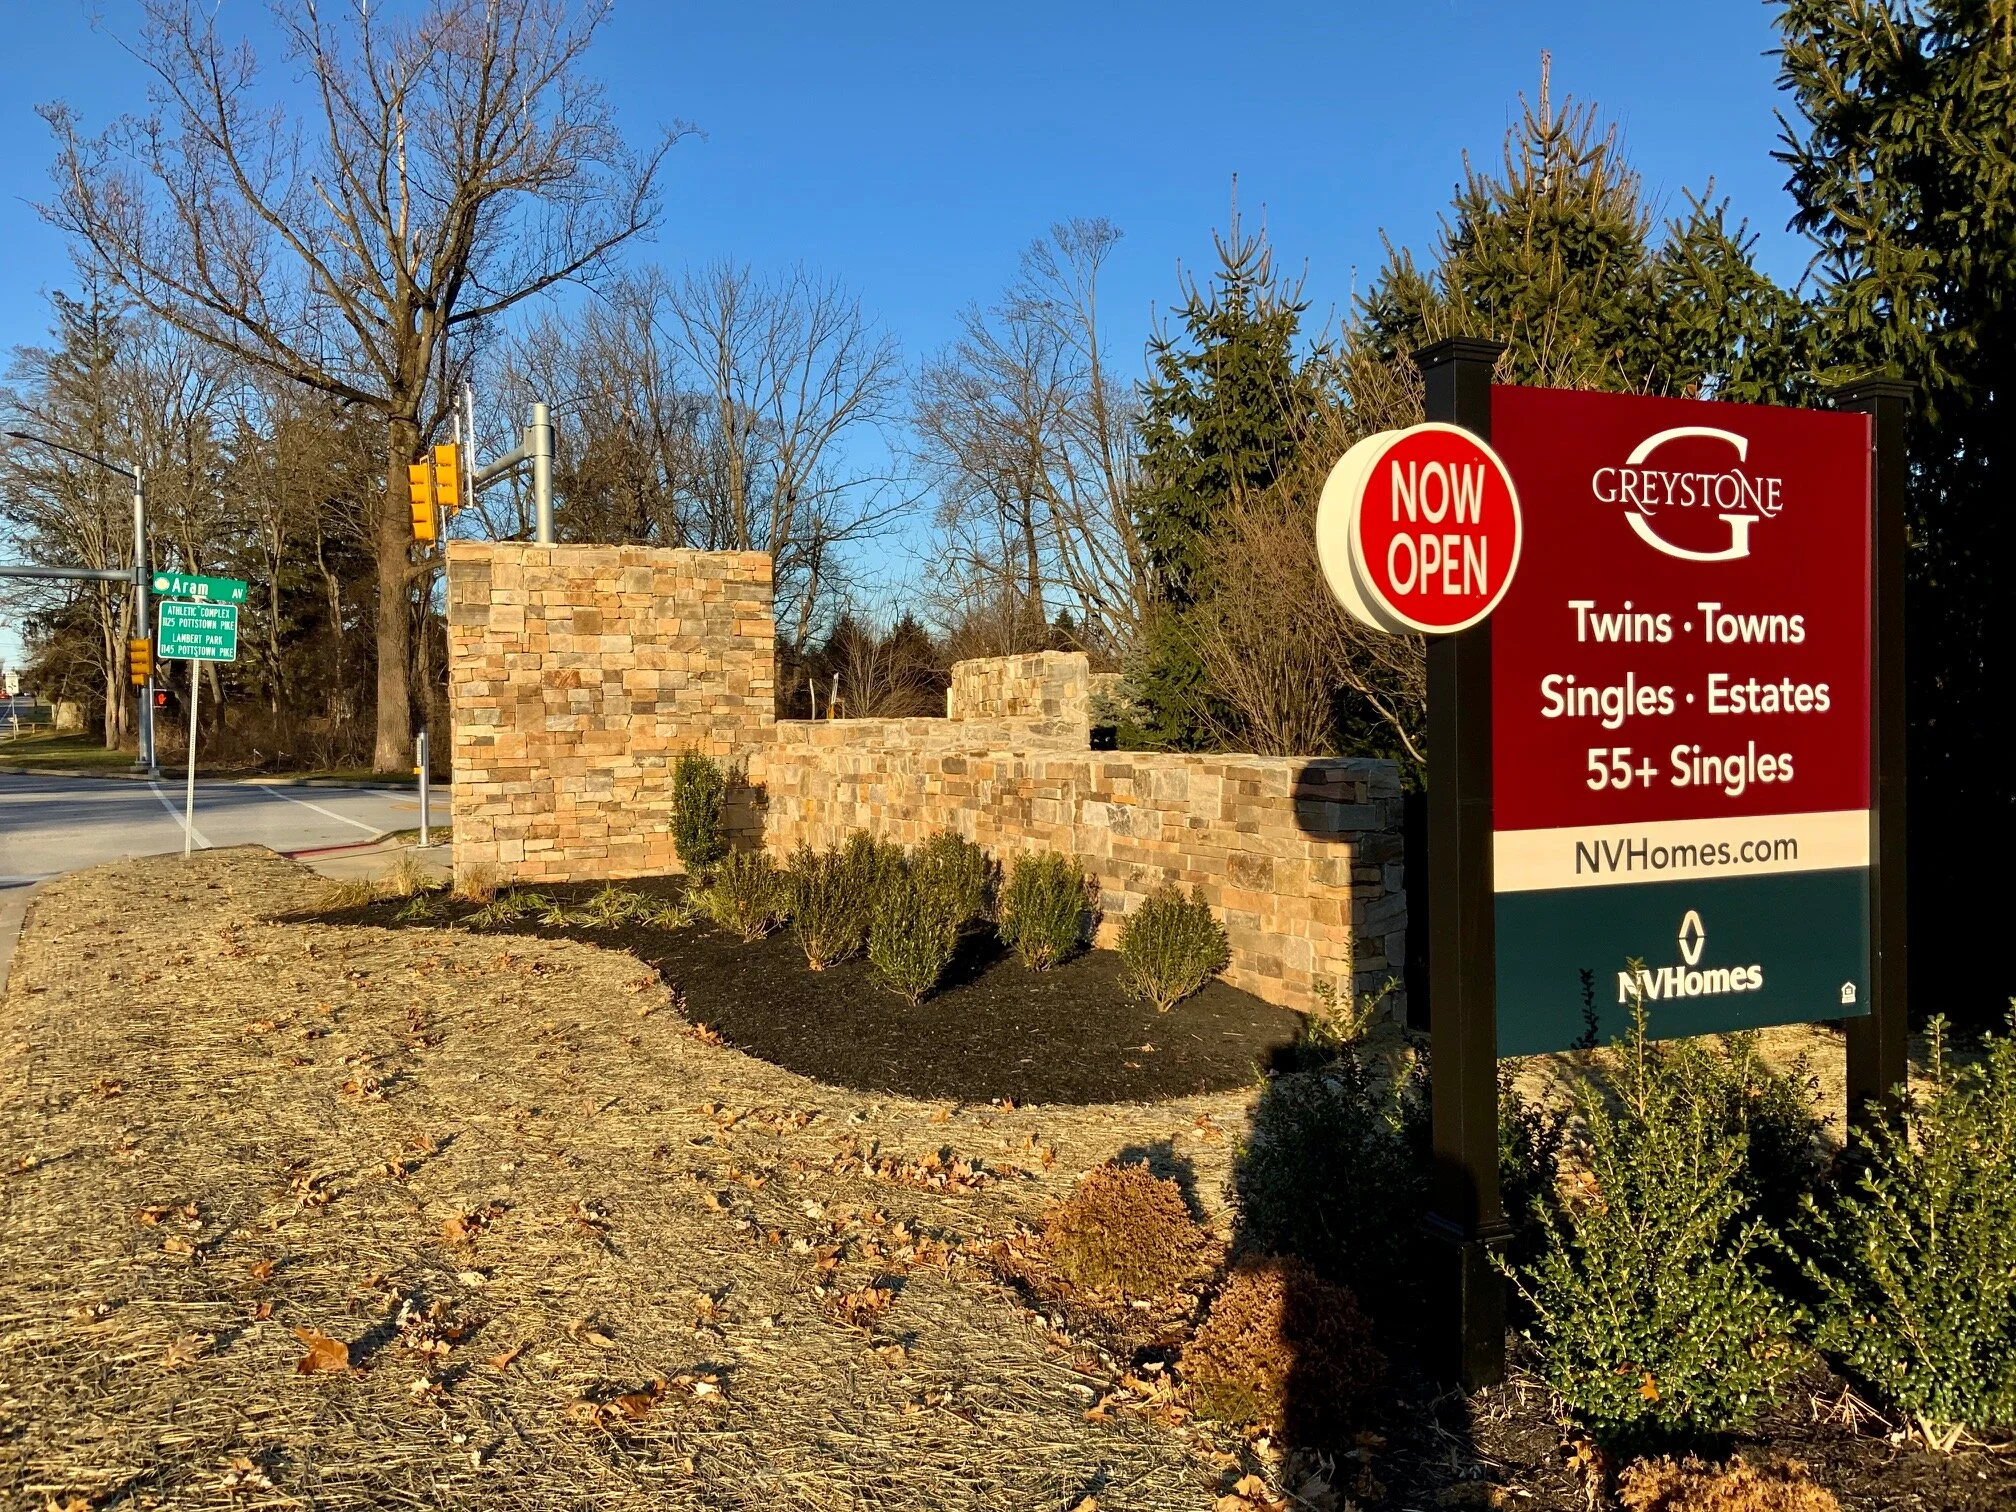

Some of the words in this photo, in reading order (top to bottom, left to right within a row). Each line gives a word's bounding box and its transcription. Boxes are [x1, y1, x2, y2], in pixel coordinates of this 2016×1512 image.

[1391, 459, 1486, 525] NOW
[1591, 466, 1784, 518] GREYSTONE
[1387, 532, 1488, 596] OPEN
[172, 578, 208, 596] Aram
[232, 588, 242, 598] AV
[163, 618, 175, 626] 1125
[179, 620, 216, 630] POTTSTOWN
[221, 620, 234, 630] PIKE
[168, 606, 196, 616] ATHLETIC
[201, 608, 229, 618] COMPLEX
[1568, 600, 1673, 643] Twins
[1698, 602, 1806, 643] Towns
[161, 644, 174, 654] 1145
[178, 646, 215, 656] POTTSTOWN
[220, 648, 233, 658] PIKE
[173, 634, 202, 644] LAMBERT
[206, 636, 222, 646] PARK
[1540, 671, 1675, 729] Singles
[1707, 673, 1831, 714] Estates
[1586, 747, 1658, 791] 55+
[1670, 741, 1794, 796] Singles
[1575, 837, 1799, 875] NVHomes.com
[1617, 964, 1764, 1003] NVHomes
